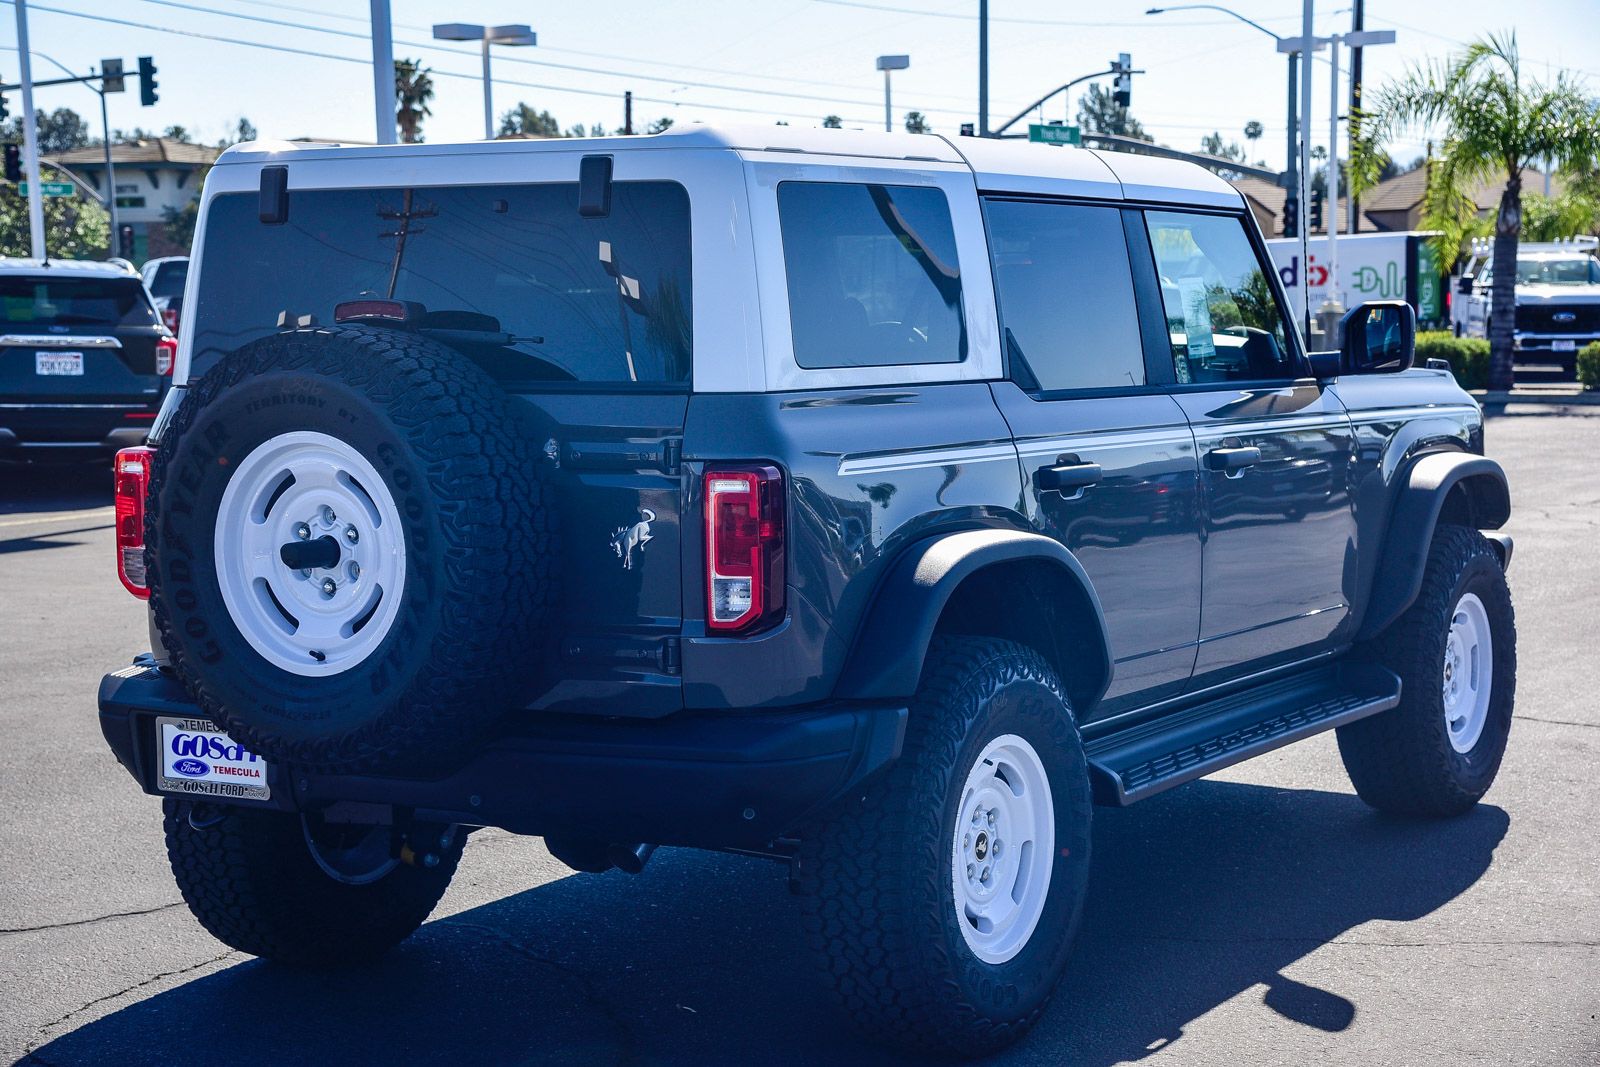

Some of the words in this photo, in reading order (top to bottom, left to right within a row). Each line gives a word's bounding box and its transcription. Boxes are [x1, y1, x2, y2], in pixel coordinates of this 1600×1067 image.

[246, 394, 327, 414] TERRITORY
[183, 720, 227, 732] TEMEC
[180, 761, 202, 773] Ford
[213, 765, 260, 778] TEMECULA
[220, 784, 244, 797] FORD
